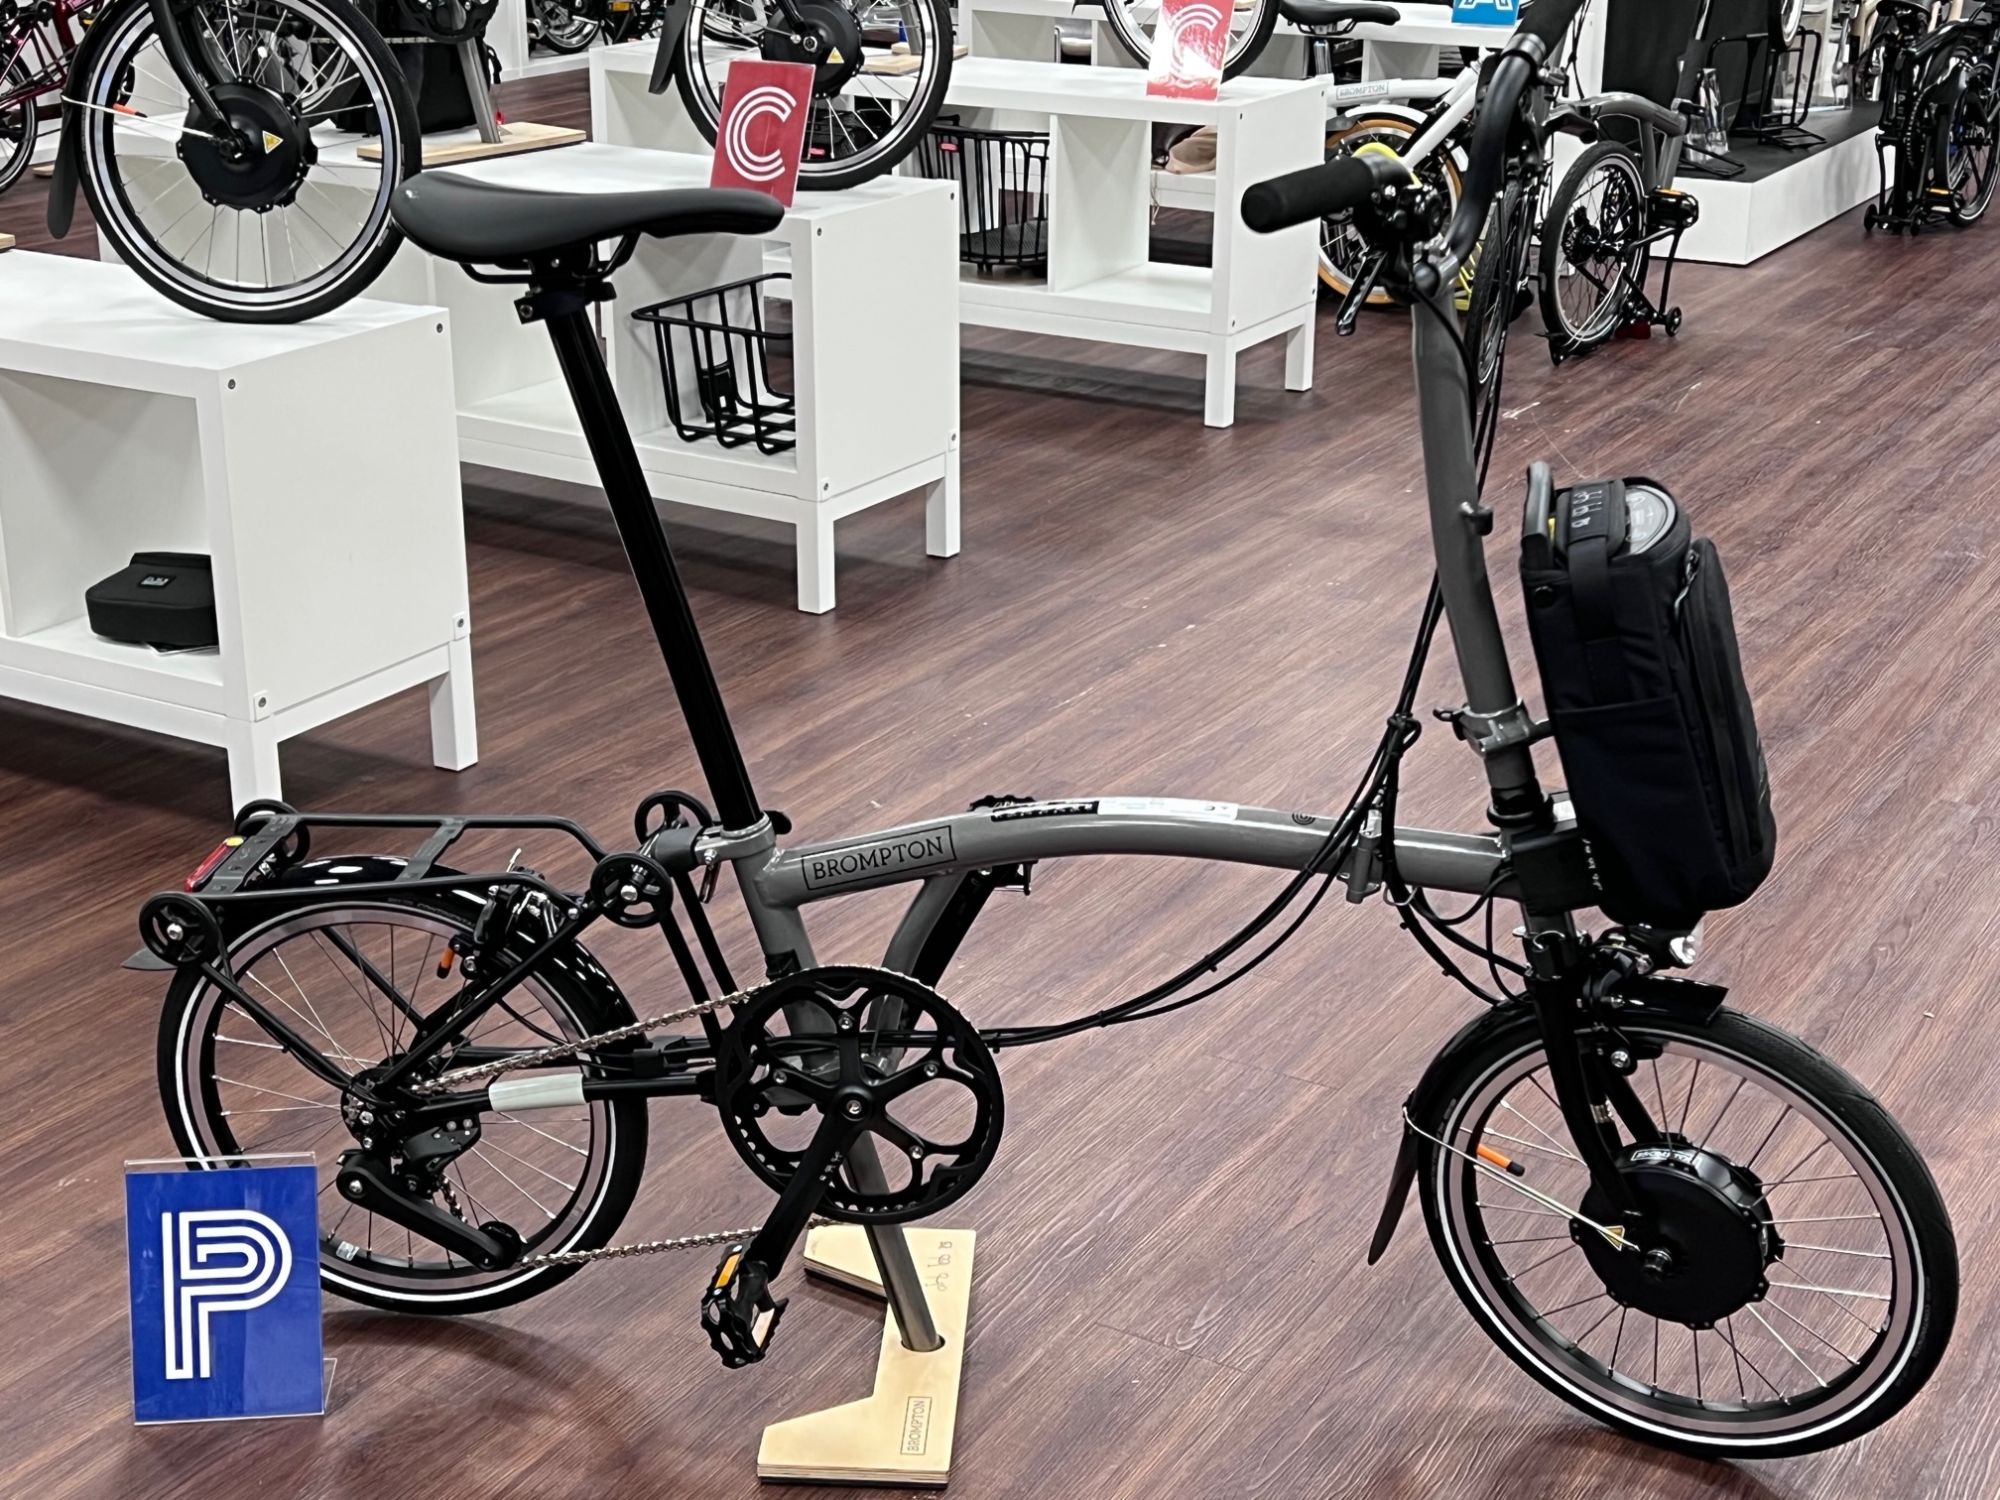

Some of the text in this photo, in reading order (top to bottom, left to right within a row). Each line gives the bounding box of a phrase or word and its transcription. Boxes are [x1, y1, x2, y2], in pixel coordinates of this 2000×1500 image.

[725, 85, 797, 182] C
[812, 836, 944, 880] BROMPTON
[161, 1208, 293, 1380] P
[907, 1400, 925, 1451] BROMPTON
